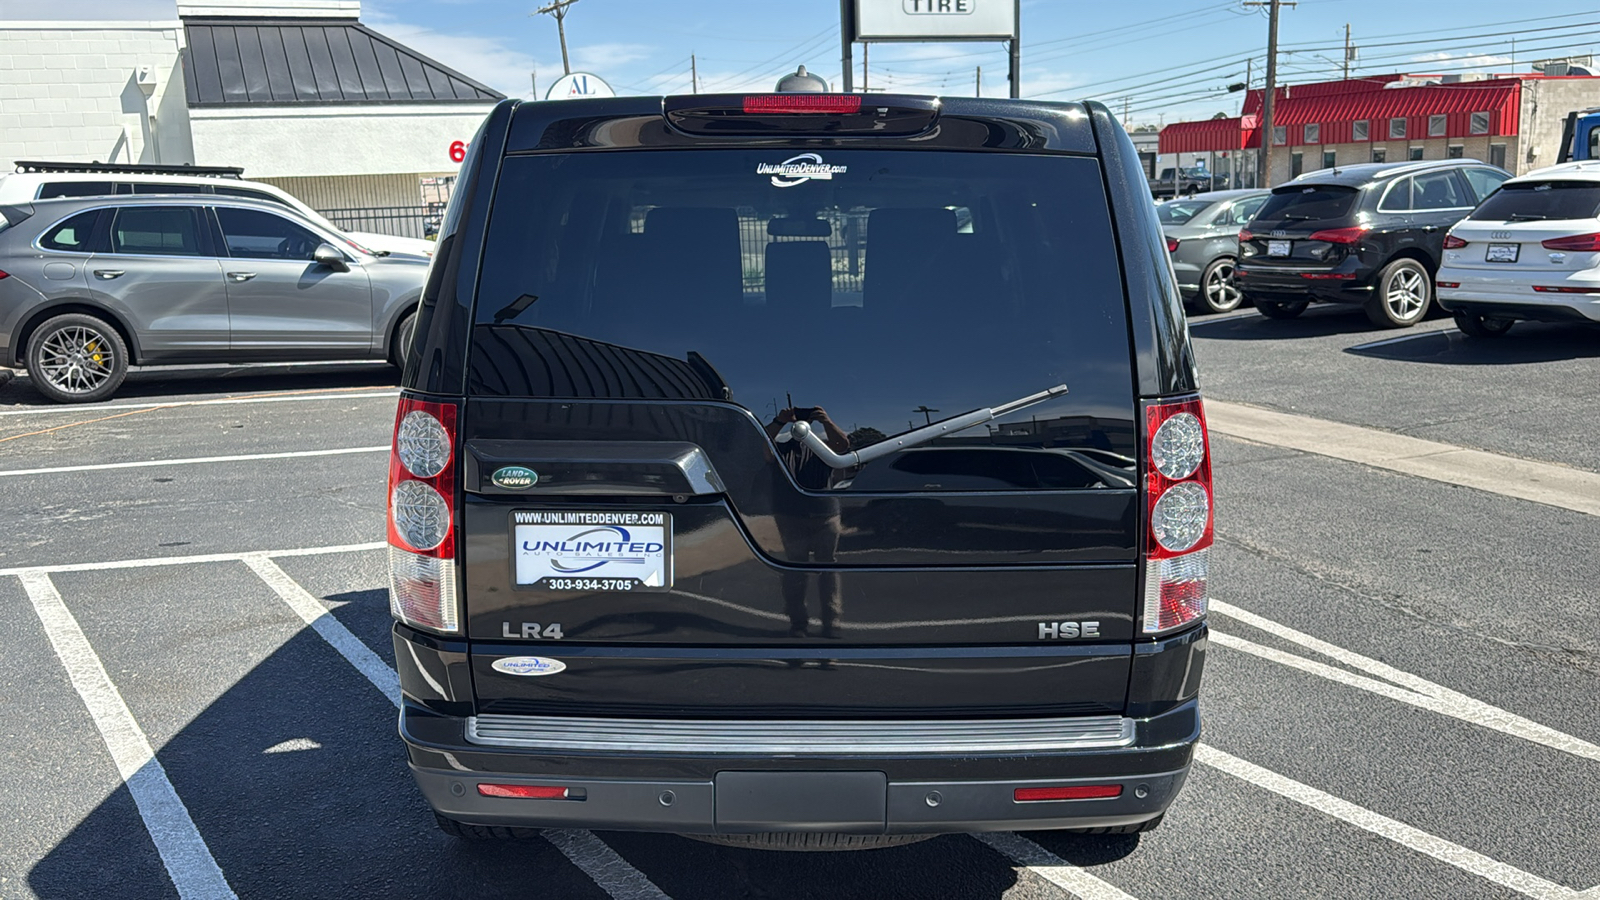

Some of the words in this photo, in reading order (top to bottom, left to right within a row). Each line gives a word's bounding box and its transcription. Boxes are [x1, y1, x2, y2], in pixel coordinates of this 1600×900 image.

[910, 0, 967, 12] TIRE
[568, 75, 596, 95] AL
[449, 140, 470, 163] 6
[515, 513, 664, 525] WWW.UNLIMITEDDENVER.COM
[523, 541, 663, 553] UNLIMITED
[549, 579, 632, 591] 303-934-3705
[503, 621, 564, 639] LR4
[1038, 621, 1100, 639] HSE
